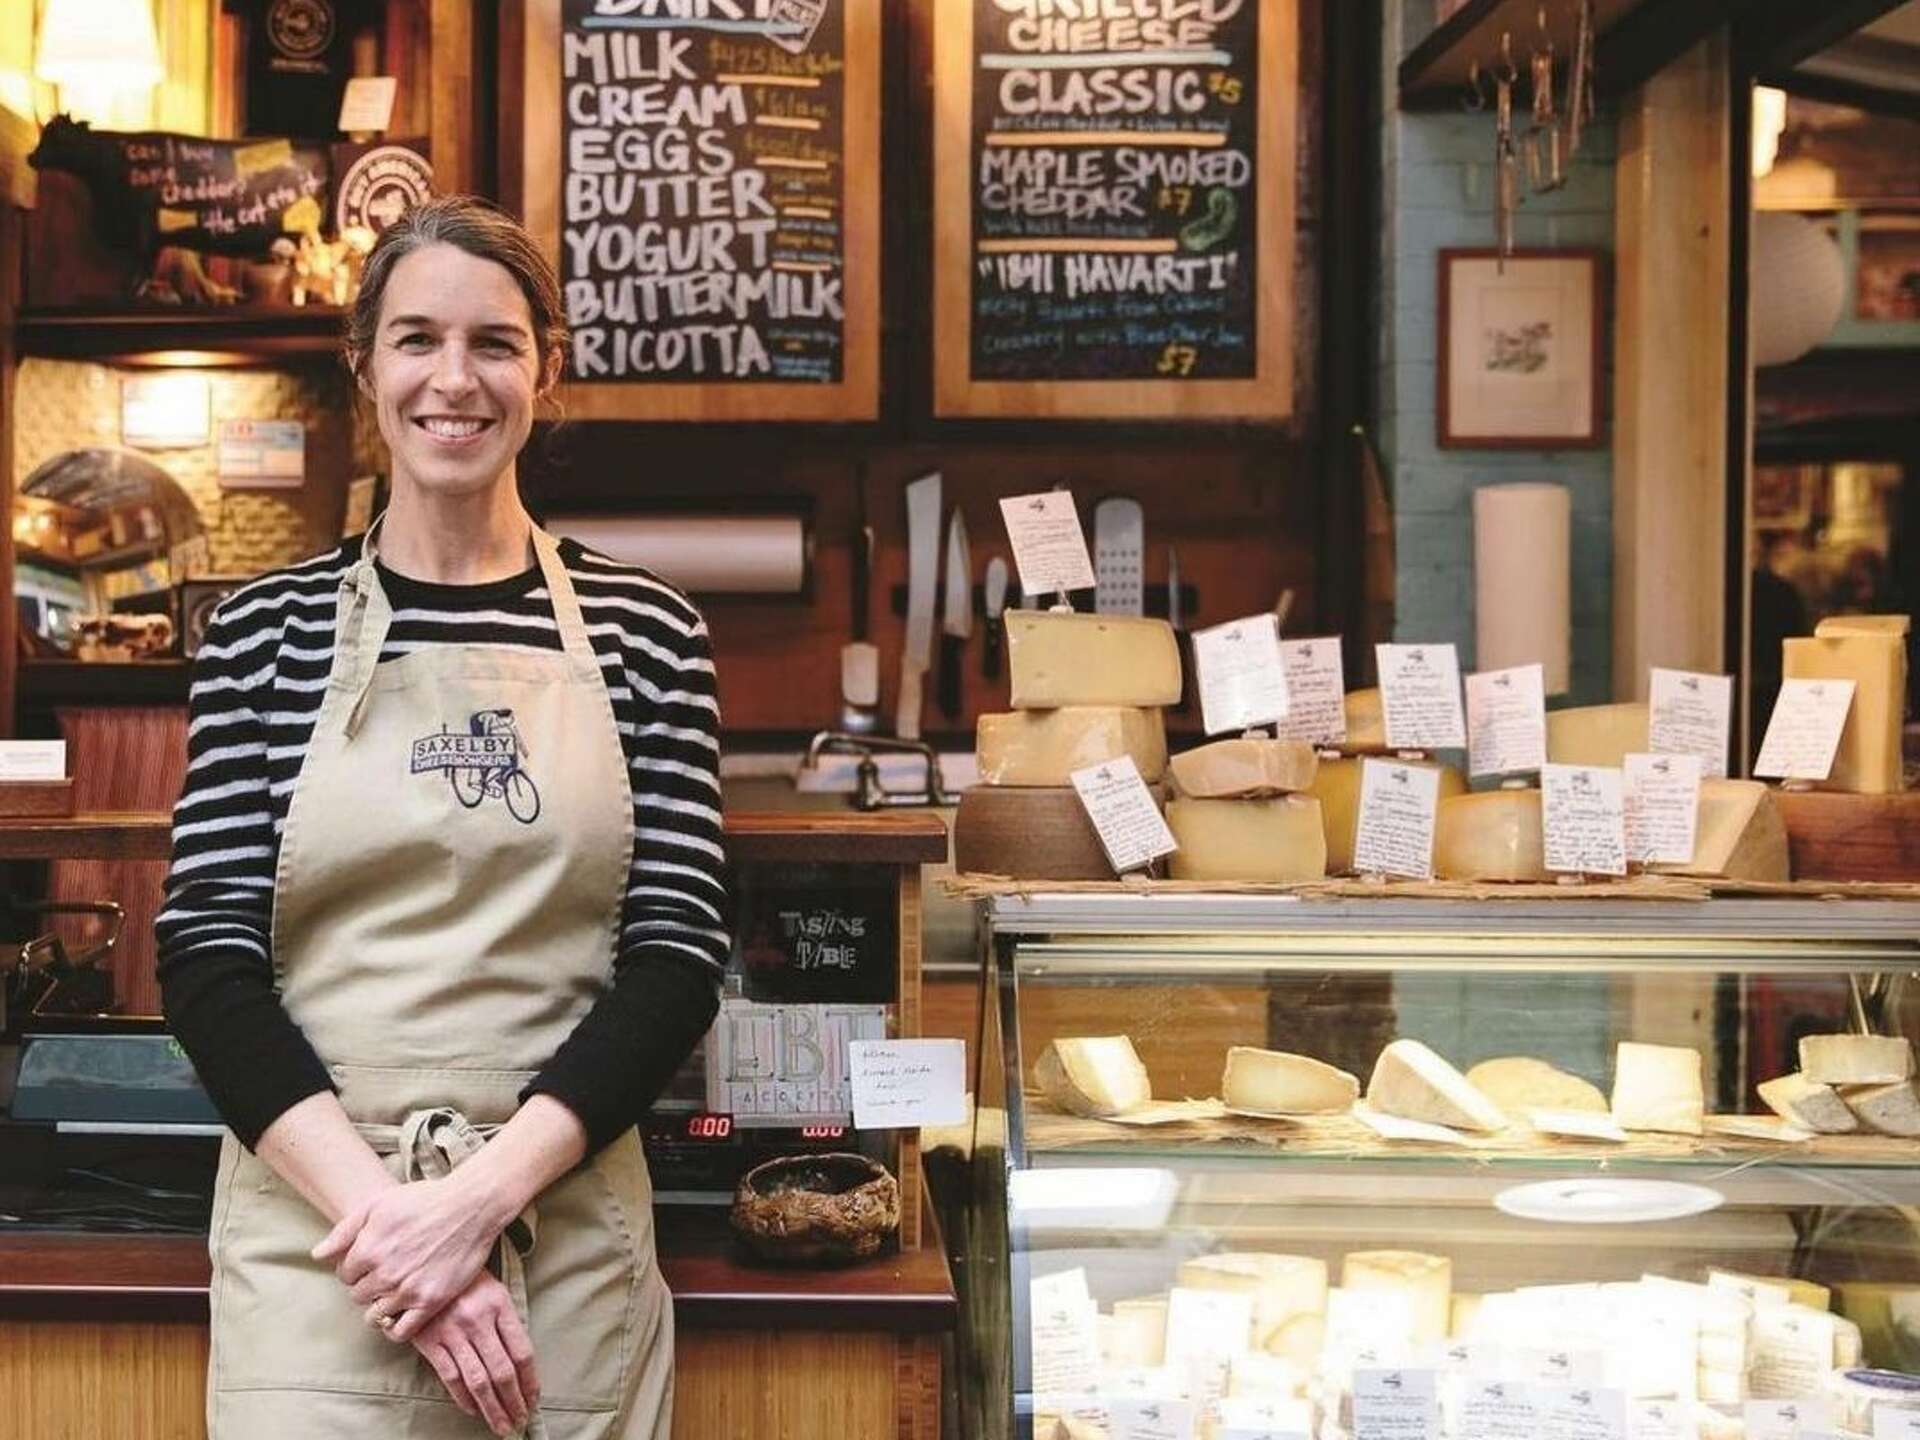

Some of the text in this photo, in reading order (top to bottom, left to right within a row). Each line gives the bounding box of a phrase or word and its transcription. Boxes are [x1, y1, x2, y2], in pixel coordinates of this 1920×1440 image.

[564, 31, 697, 84] MILK
[1007, 17, 1217, 52] CHEESE
[568, 83, 748, 127] CREAM
[1000, 69, 1243, 115] CLASSIC $5
[569, 127, 735, 175] EGGS
[980, 148, 1251, 188] MAPLE SMOKED
[566, 169, 777, 221] BUTTER
[981, 185, 1146, 219] CHEDDAR
[564, 219, 778, 278] YOGURT
[564, 269, 845, 326] BUTTERMILK
[573, 324, 772, 378] RICOTTA
[416, 737, 511, 757] SAXELBY
